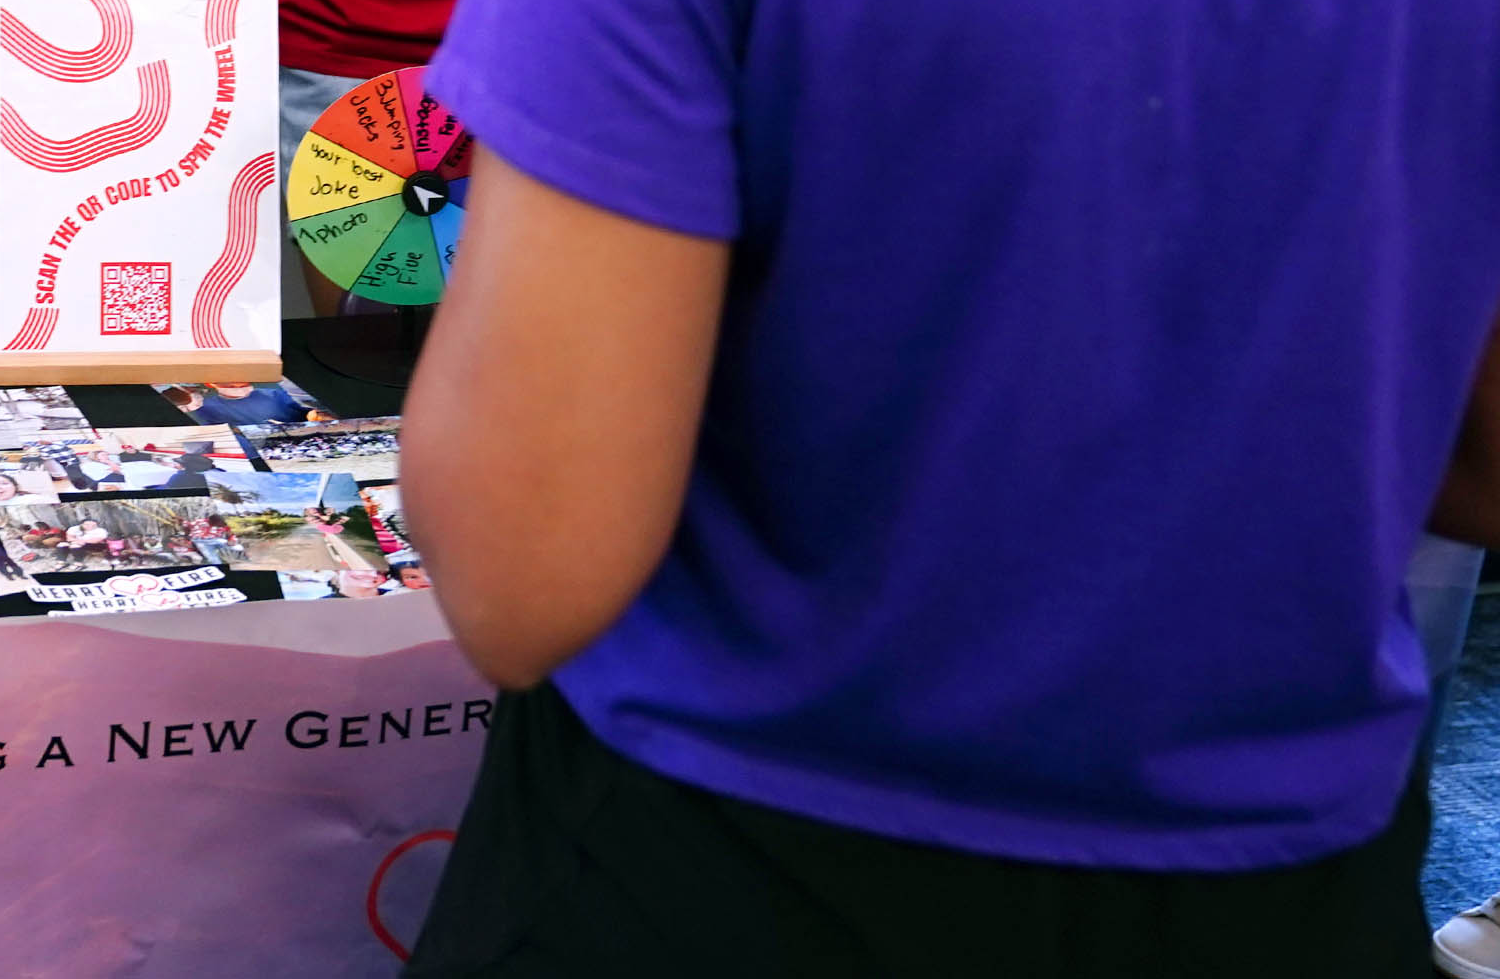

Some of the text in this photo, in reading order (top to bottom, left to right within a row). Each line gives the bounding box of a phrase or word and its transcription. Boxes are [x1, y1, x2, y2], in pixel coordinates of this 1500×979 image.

[349, 94, 379, 142] Jacks
[415, 94, 439, 153] Instag
[35, 44, 237, 304] SCAN THE QR CODE TO SPIN THE WHEEL
[311, 143, 384, 181] your best
[309, 174, 361, 199] Joke
[315, 212, 368, 244] photo
[357, 251, 398, 287] High
[32, 569, 219, 600] HEART FIRE
[184, 590, 227, 603] FIRE
[106, 719, 258, 763] NEW
